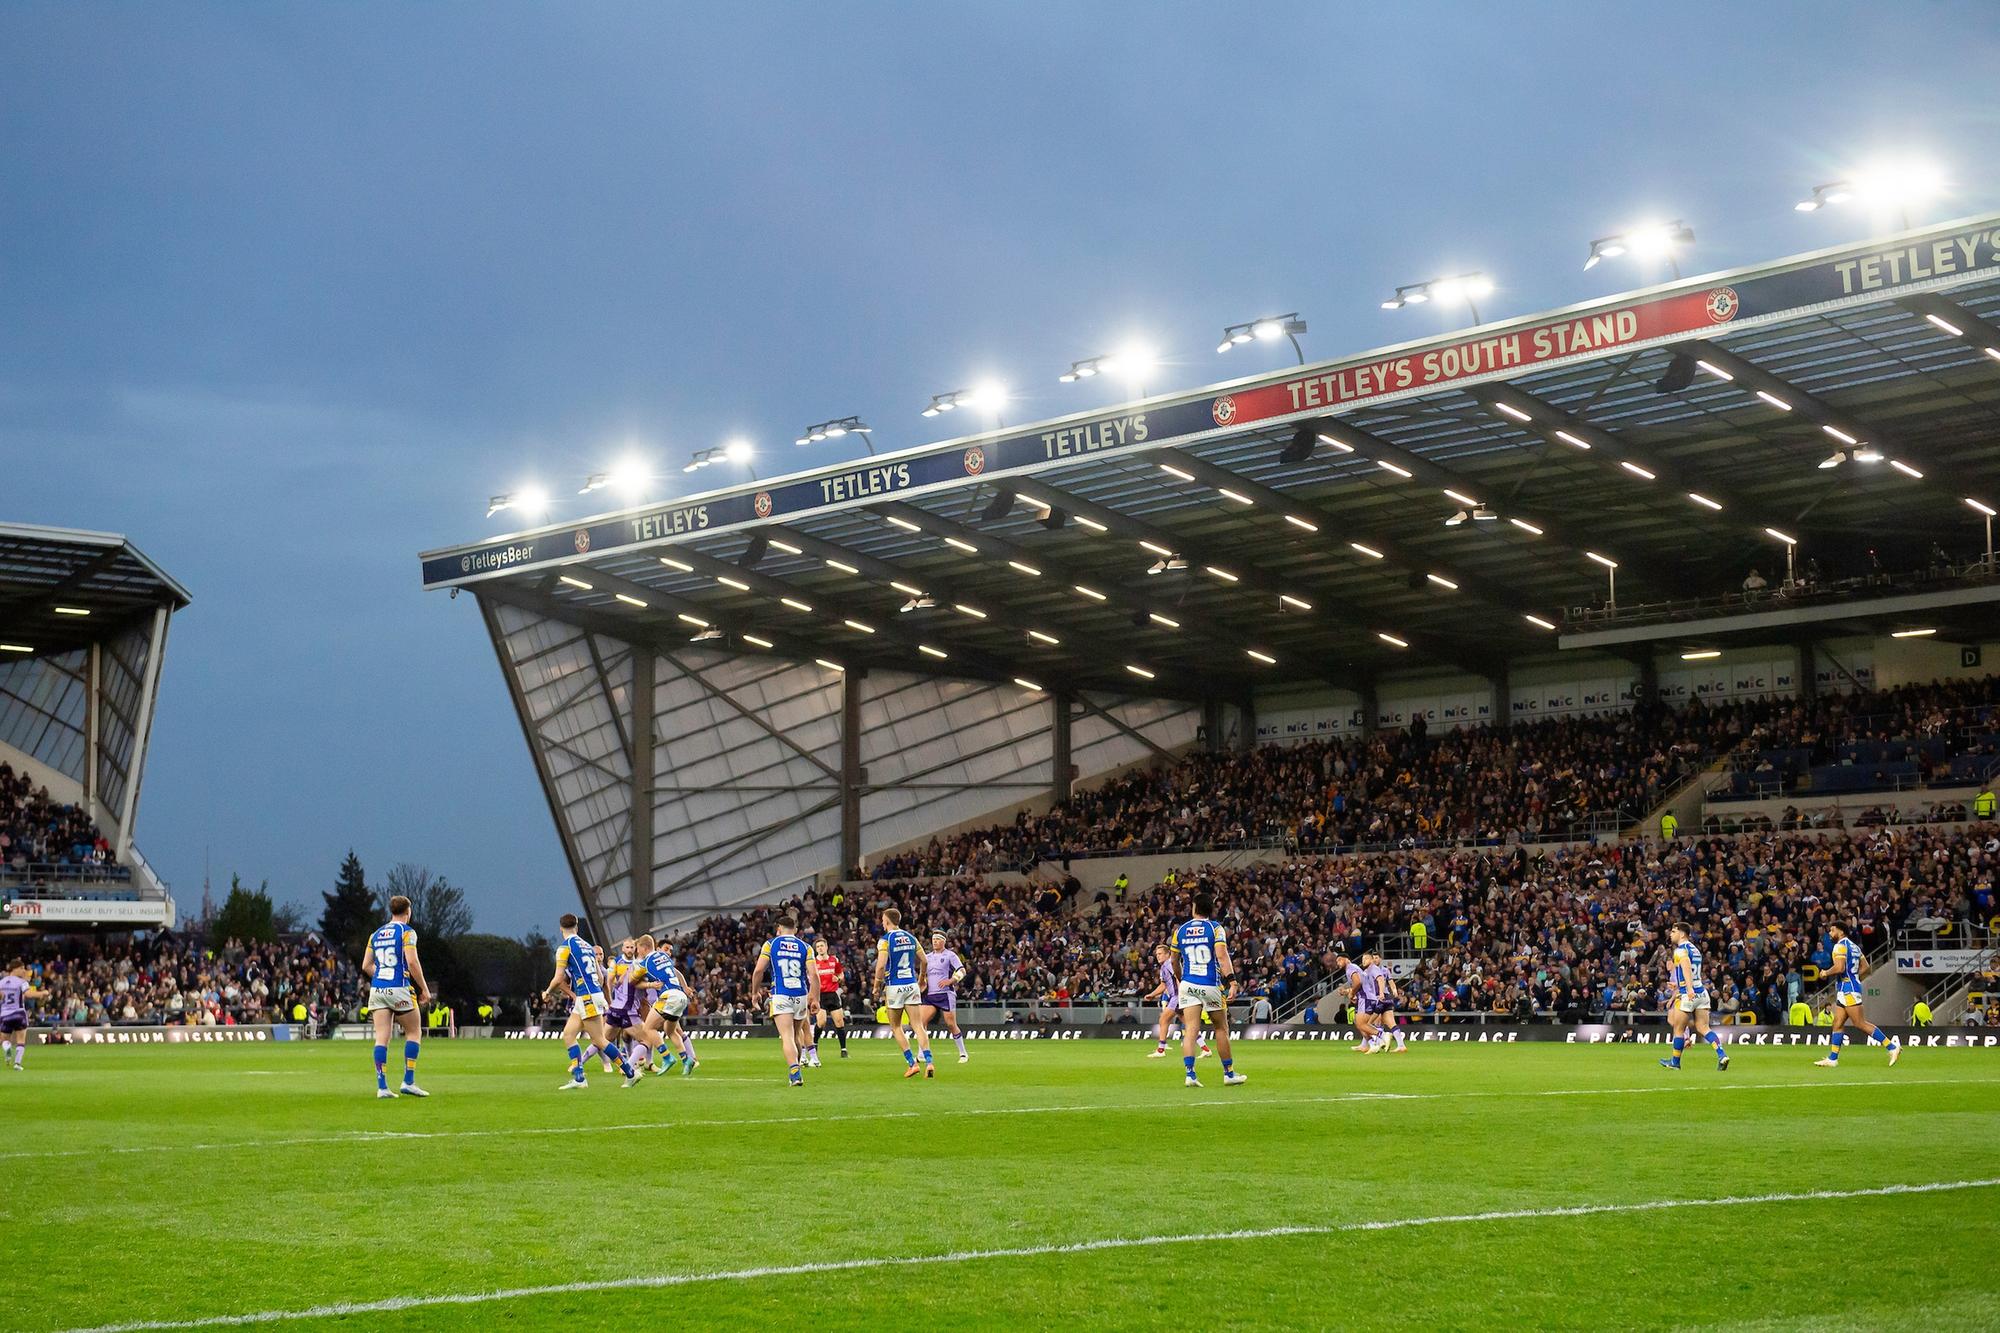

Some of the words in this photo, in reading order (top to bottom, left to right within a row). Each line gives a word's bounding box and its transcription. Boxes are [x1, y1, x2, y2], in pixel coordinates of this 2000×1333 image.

[1287, 359, 1412, 409] TETLEY'S
[1423, 335, 1520, 381] SOUTH
[1533, 310, 1638, 358] STAND
[1041, 415, 1148, 459] TETLEY'S
[821, 463, 910, 503] TETLEY'S
[631, 505, 708, 541] TETLEY'S
[461, 546, 533, 572] @TetleysBeer
[1965, 651, 1976, 664] D
[375, 946, 398, 968] 16
[897, 952, 910, 968] 4
[1184, 945, 1211, 965] 10
[777, 958, 802, 978] 18
[375, 987, 393, 996] AXIS
[897, 986, 913, 994] AXIS
[1187, 987, 1206, 997] AXIS
[39, 1032, 73, 1043] TE
[83, 1032, 164, 1044] PREMIUM
[173, 1031, 266, 1042] TICKETING
[505, 1031, 525, 1039] THE
[966, 1031, 1082, 1039] MARKETPACE
[1121, 1031, 1152, 1039] THE
[1251, 1031, 1354, 1040] TICKETING
[1717, 1033, 1850, 1045] ICKETING
